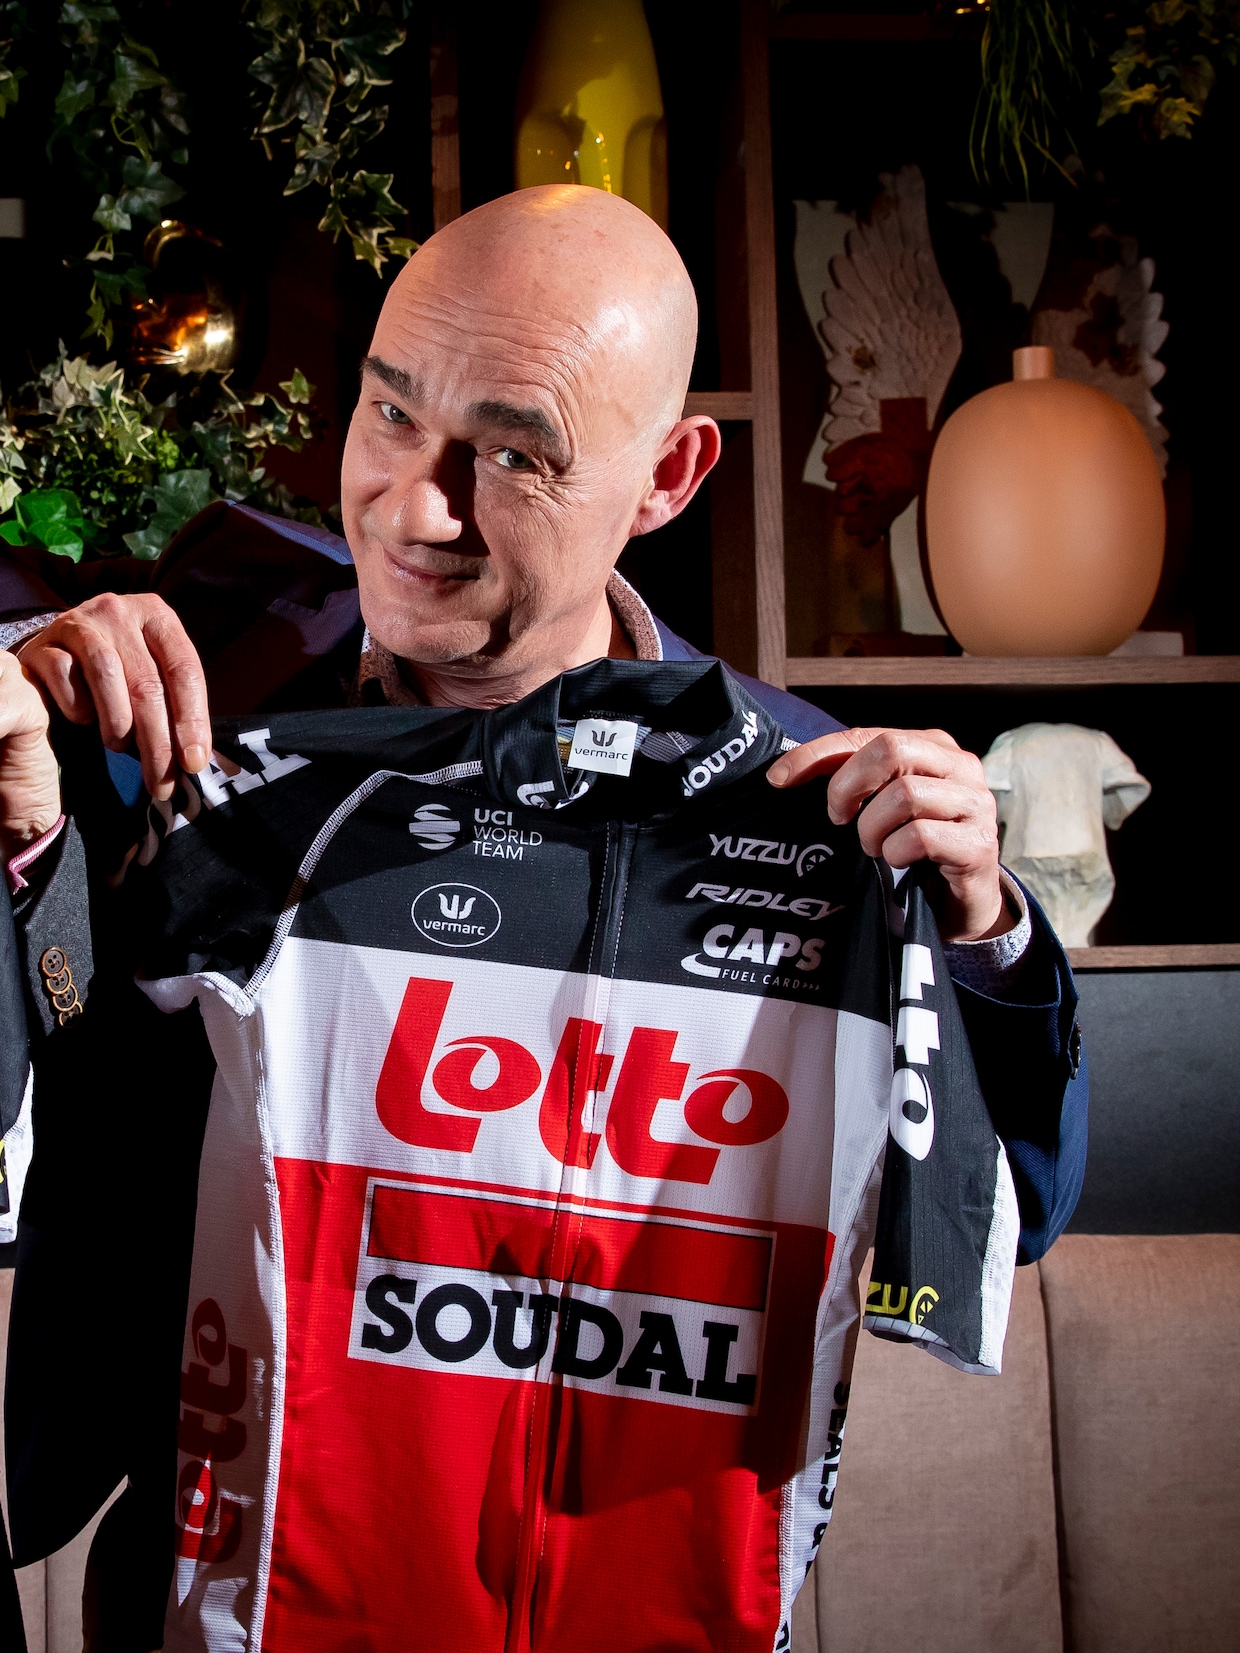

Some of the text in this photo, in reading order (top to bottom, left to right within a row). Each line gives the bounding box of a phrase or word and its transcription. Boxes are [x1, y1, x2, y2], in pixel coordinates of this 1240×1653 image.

[574, 746, 629, 762] vermarc
[474, 807, 513, 826] UCI
[473, 825, 544, 847] WORLD
[472, 840, 524, 861] TEAM
[708, 833, 799, 865] YUZZU
[685, 882, 847, 921] RIDLEY
[422, 918, 486, 936] vermarc
[702, 923, 826, 972] CAPS
[721, 968, 801, 990] FUEL CARD
[360, 1273, 757, 1406] SOUDAL
